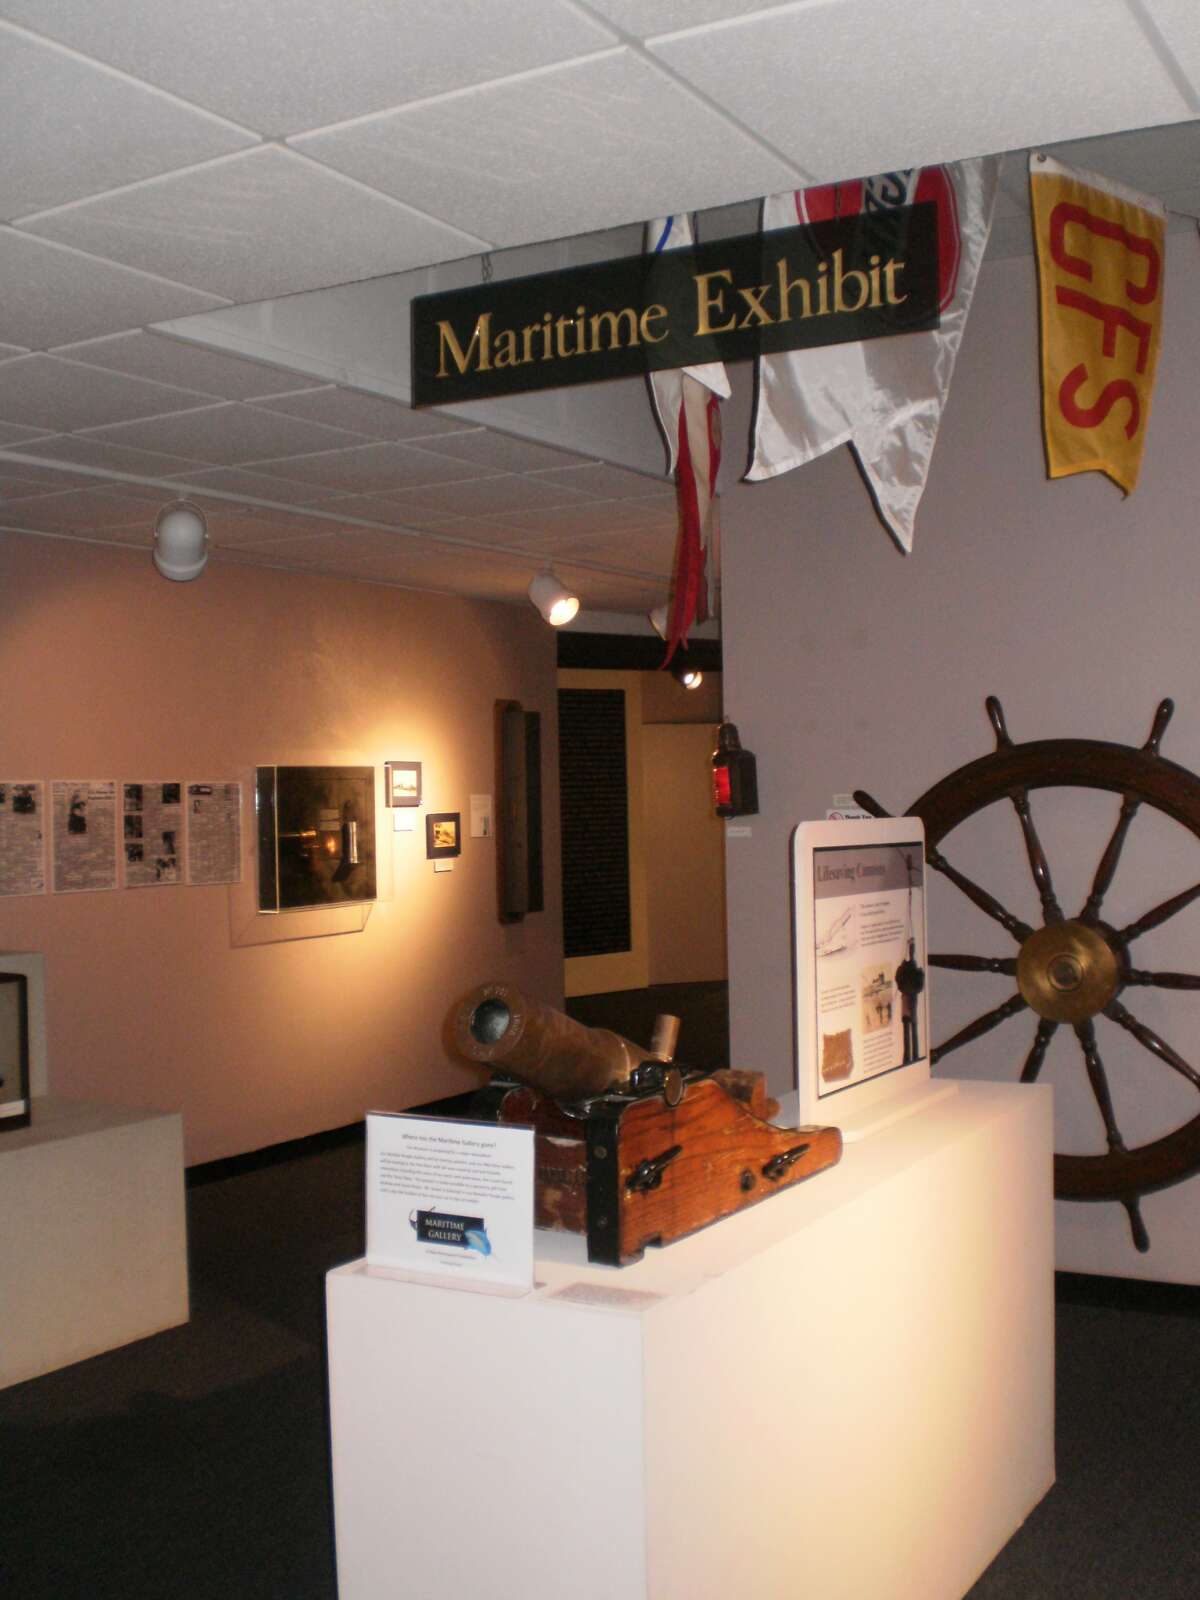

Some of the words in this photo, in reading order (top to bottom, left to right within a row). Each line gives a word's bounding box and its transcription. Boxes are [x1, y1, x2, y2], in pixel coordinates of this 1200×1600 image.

[435, 304, 669, 377] Maritime
[692, 248, 908, 336] Exhibit
[1050, 202, 1160, 441] CFS
[425, 1218, 465, 1231] MARITIME
[428, 1229, 463, 1242] GALLERY
